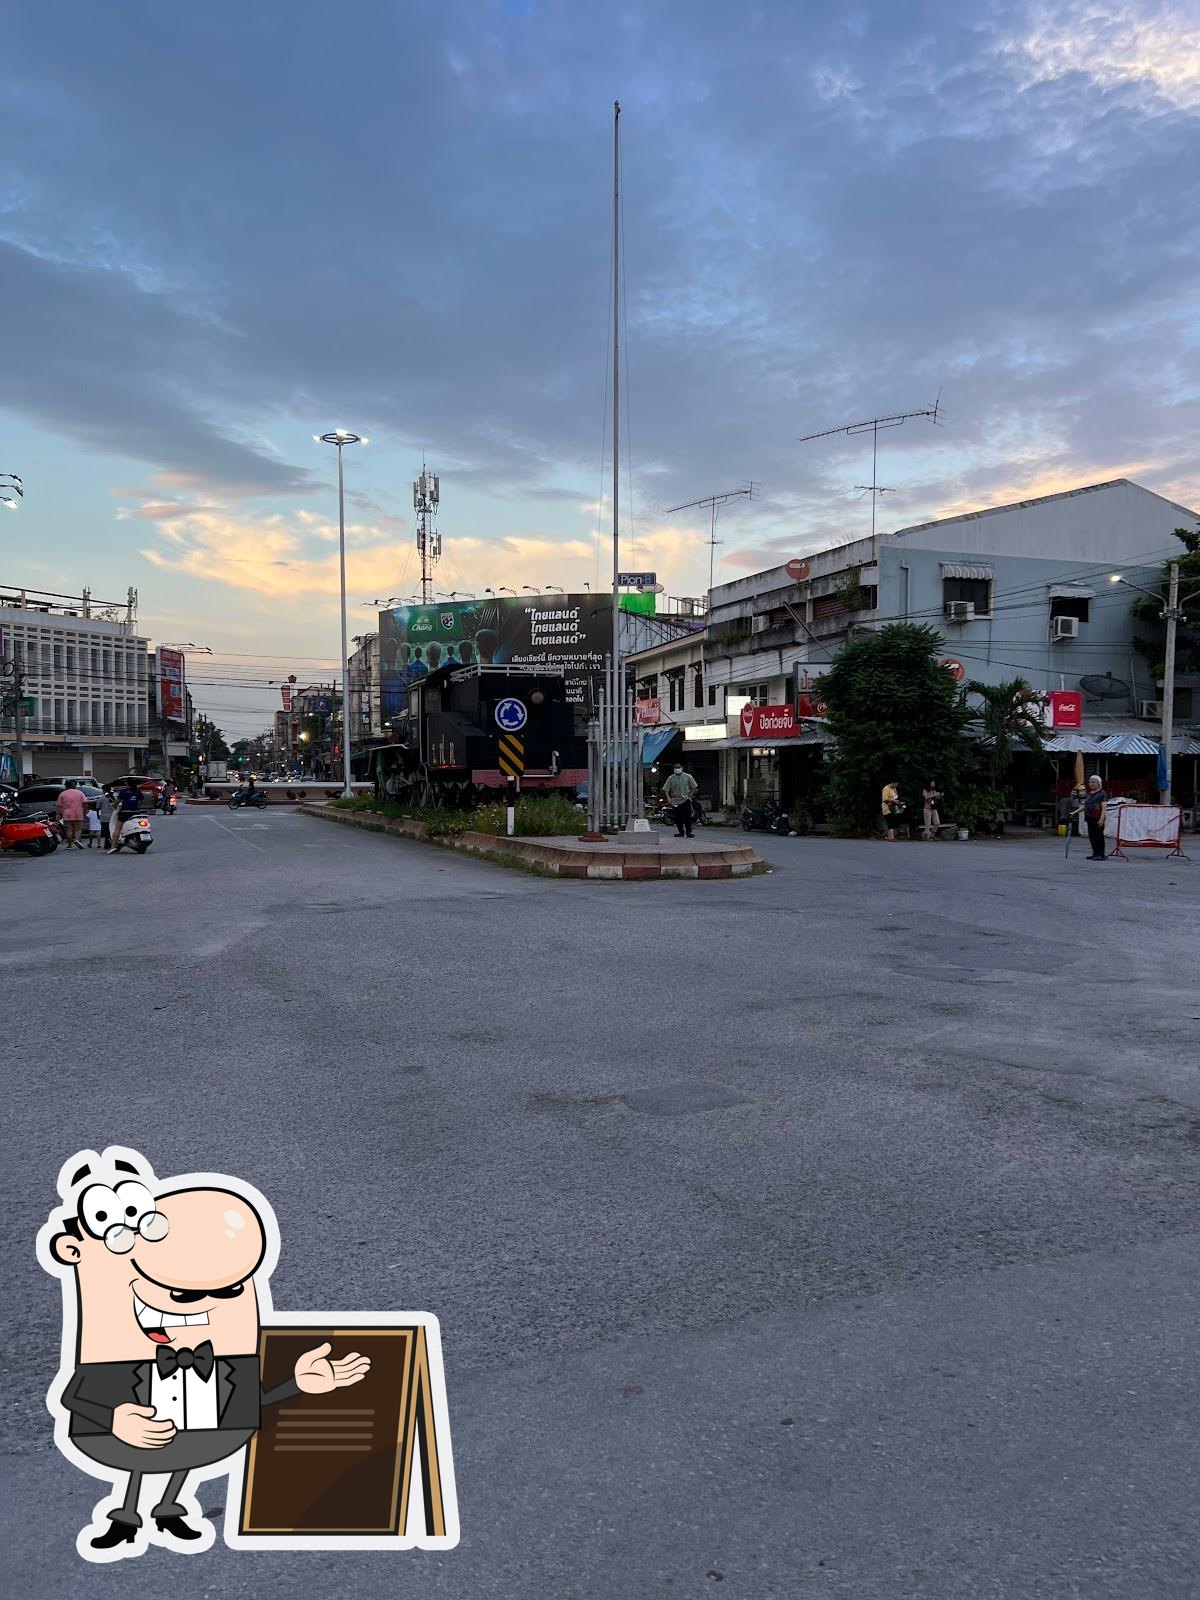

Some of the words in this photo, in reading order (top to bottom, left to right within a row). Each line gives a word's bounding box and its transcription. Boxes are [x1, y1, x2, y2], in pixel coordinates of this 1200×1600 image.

[620, 574, 643, 585] Plan
[644, 574, 652, 584] B
[411, 624, 433, 632] Chang
[530, 619, 581, 633] ไทยแลนด์
